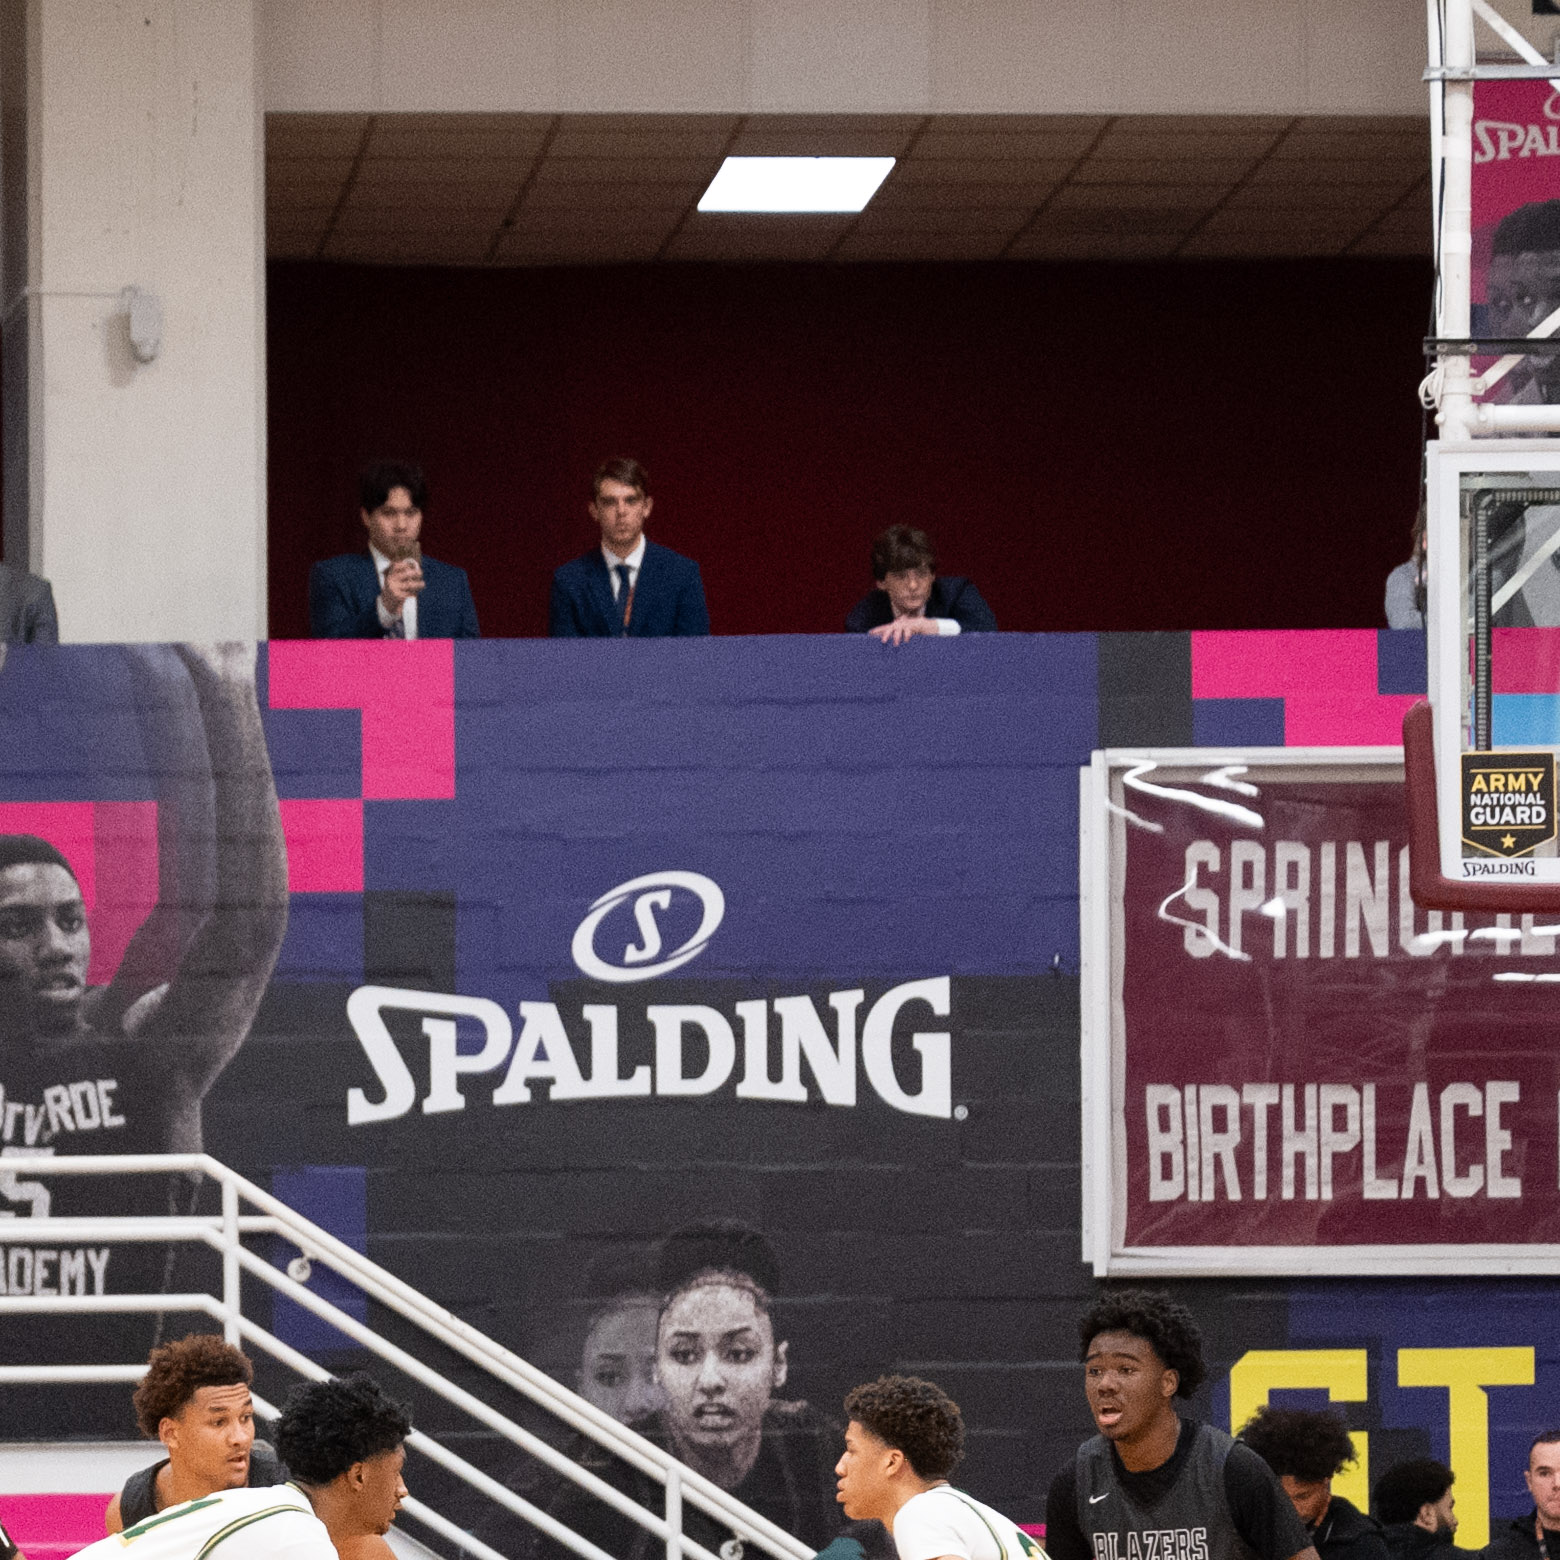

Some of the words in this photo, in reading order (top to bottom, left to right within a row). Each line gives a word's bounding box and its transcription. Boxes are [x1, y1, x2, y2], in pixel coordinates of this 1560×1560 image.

[1471, 774, 1544, 792] ARMY
[1470, 793, 1545, 805] NATIONAL
[1470, 806, 1546, 825] GUARD
[1463, 862, 1535, 877] SPALDING
[347, 976, 952, 1124] SPALDING
[1145, 1081, 1522, 1202] BIRTHPLACE
